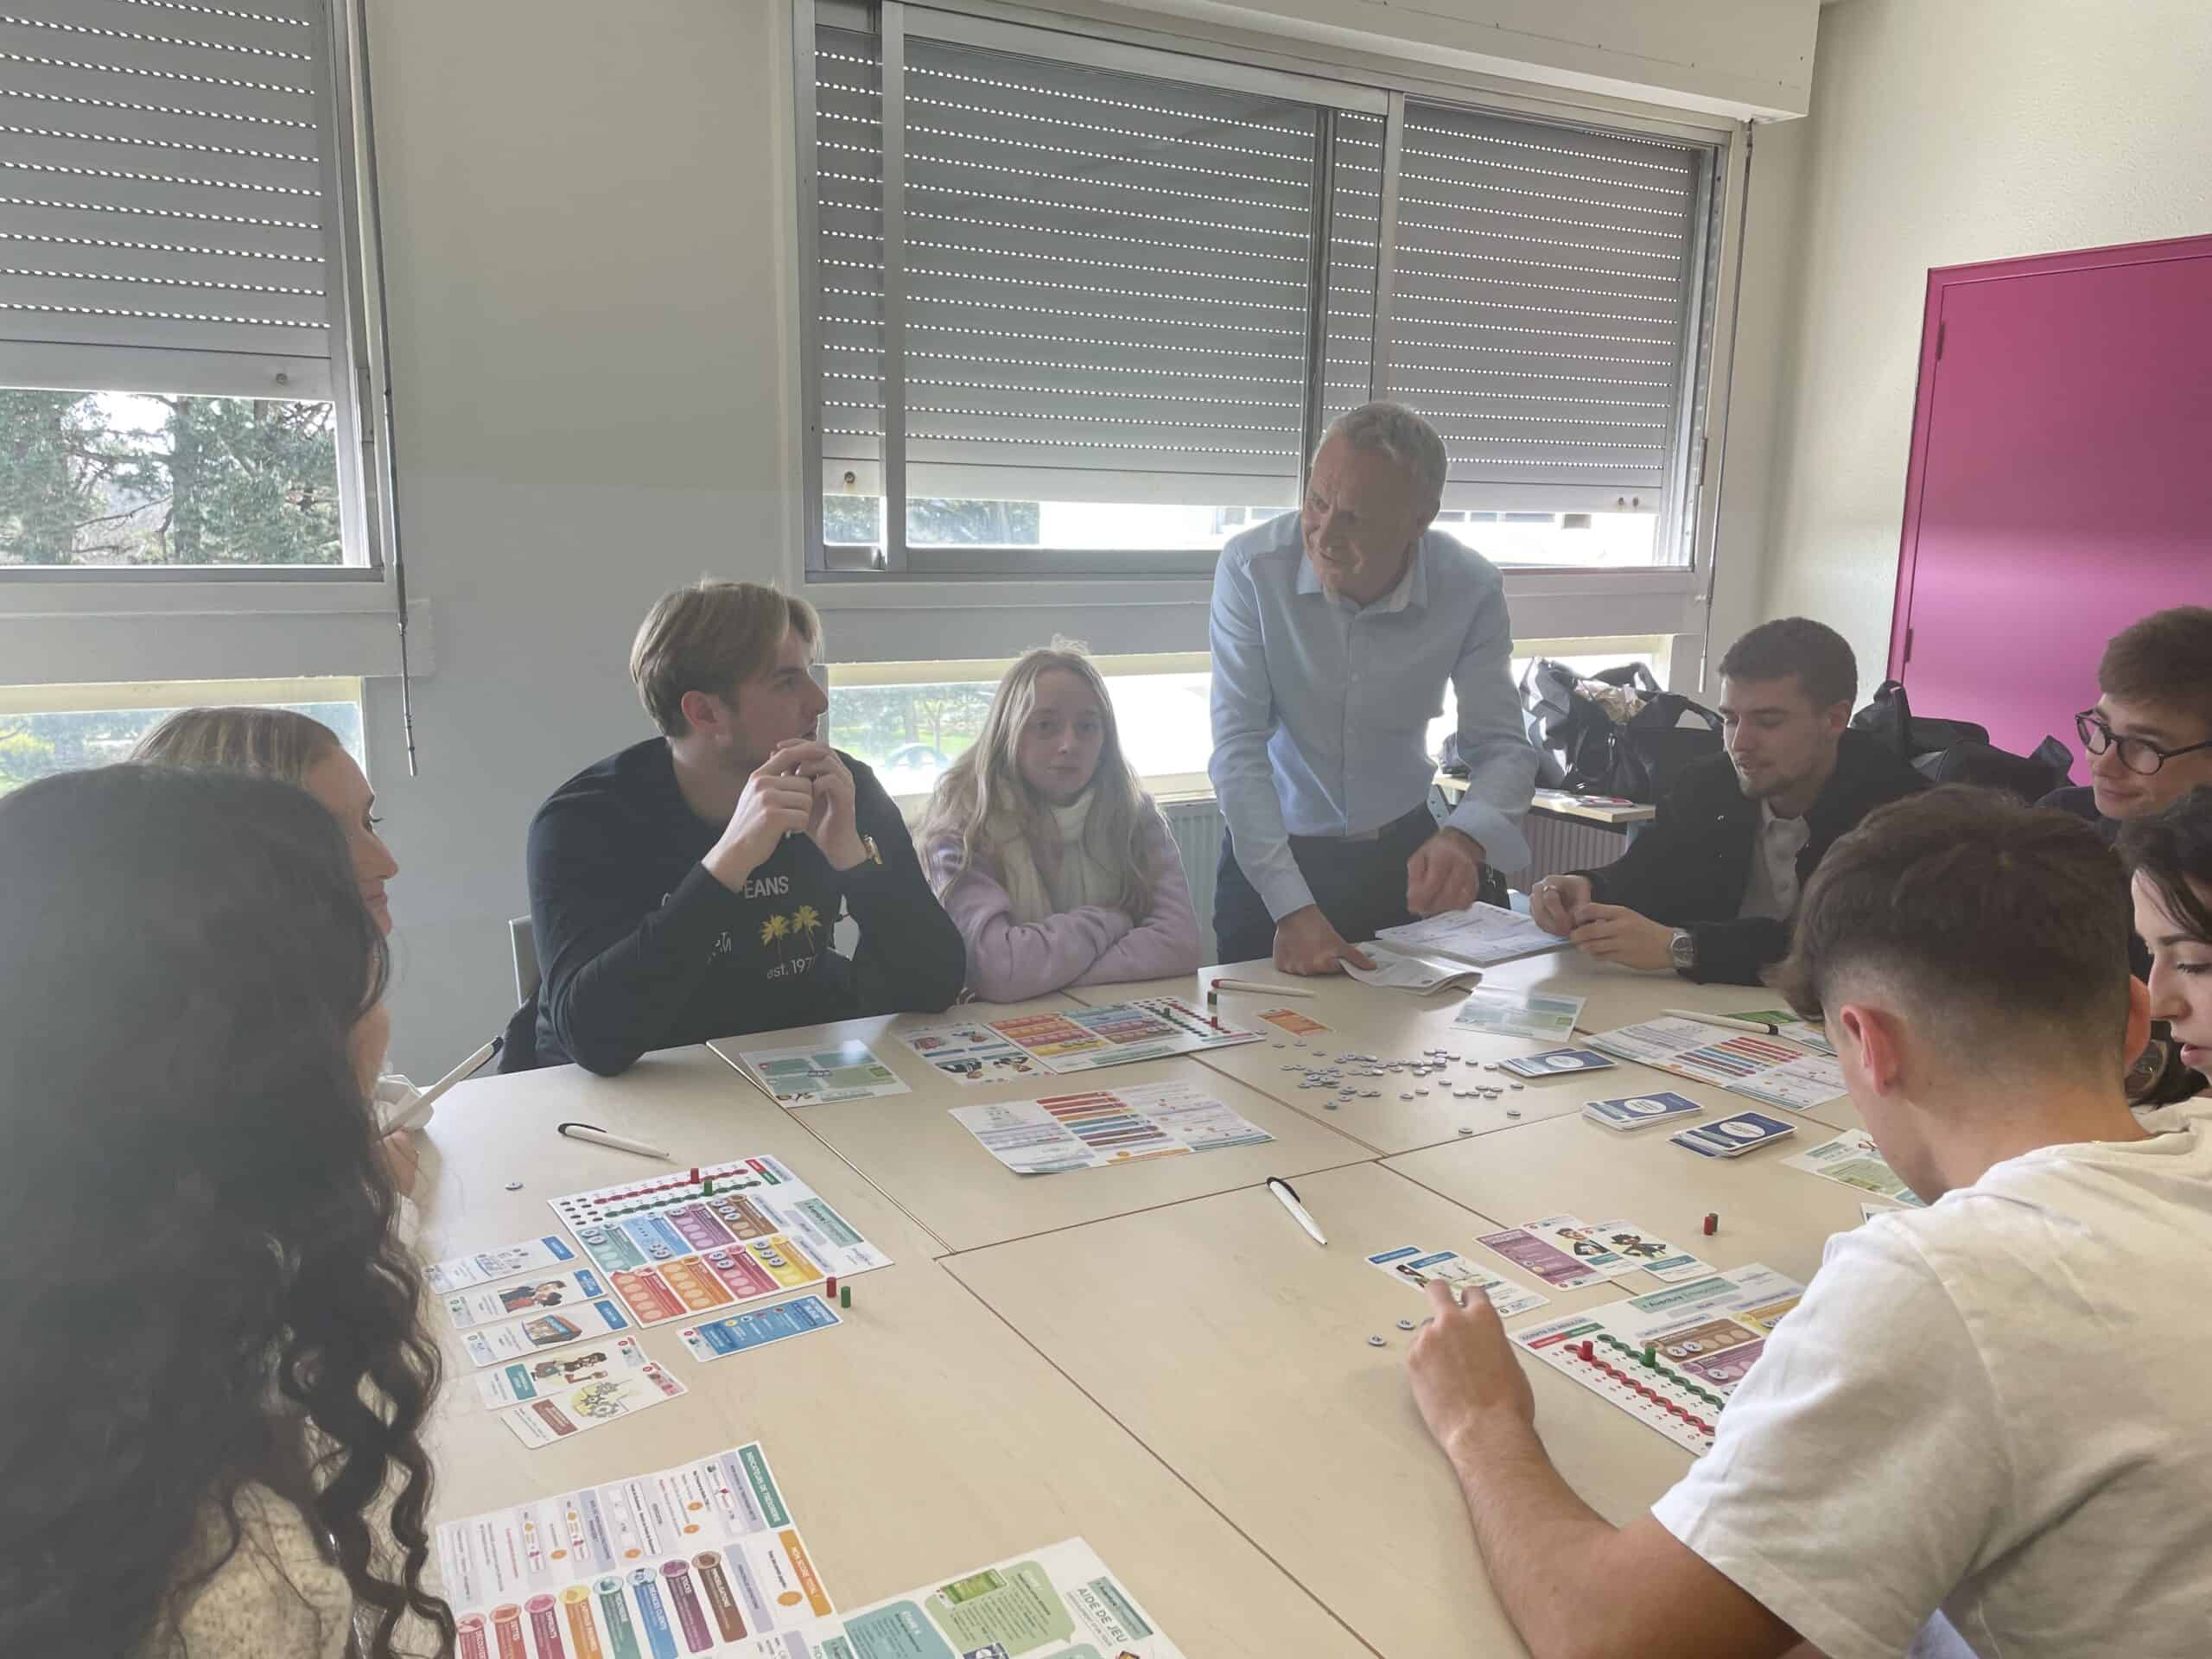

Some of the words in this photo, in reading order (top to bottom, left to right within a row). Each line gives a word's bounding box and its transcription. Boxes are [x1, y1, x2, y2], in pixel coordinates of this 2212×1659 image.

[791, 956, 816, 975] 197
[1077, 1589, 1100, 1610] AIDE
[1096, 1610, 1112, 1624] DE
[1107, 1625, 1128, 1643] JEU
